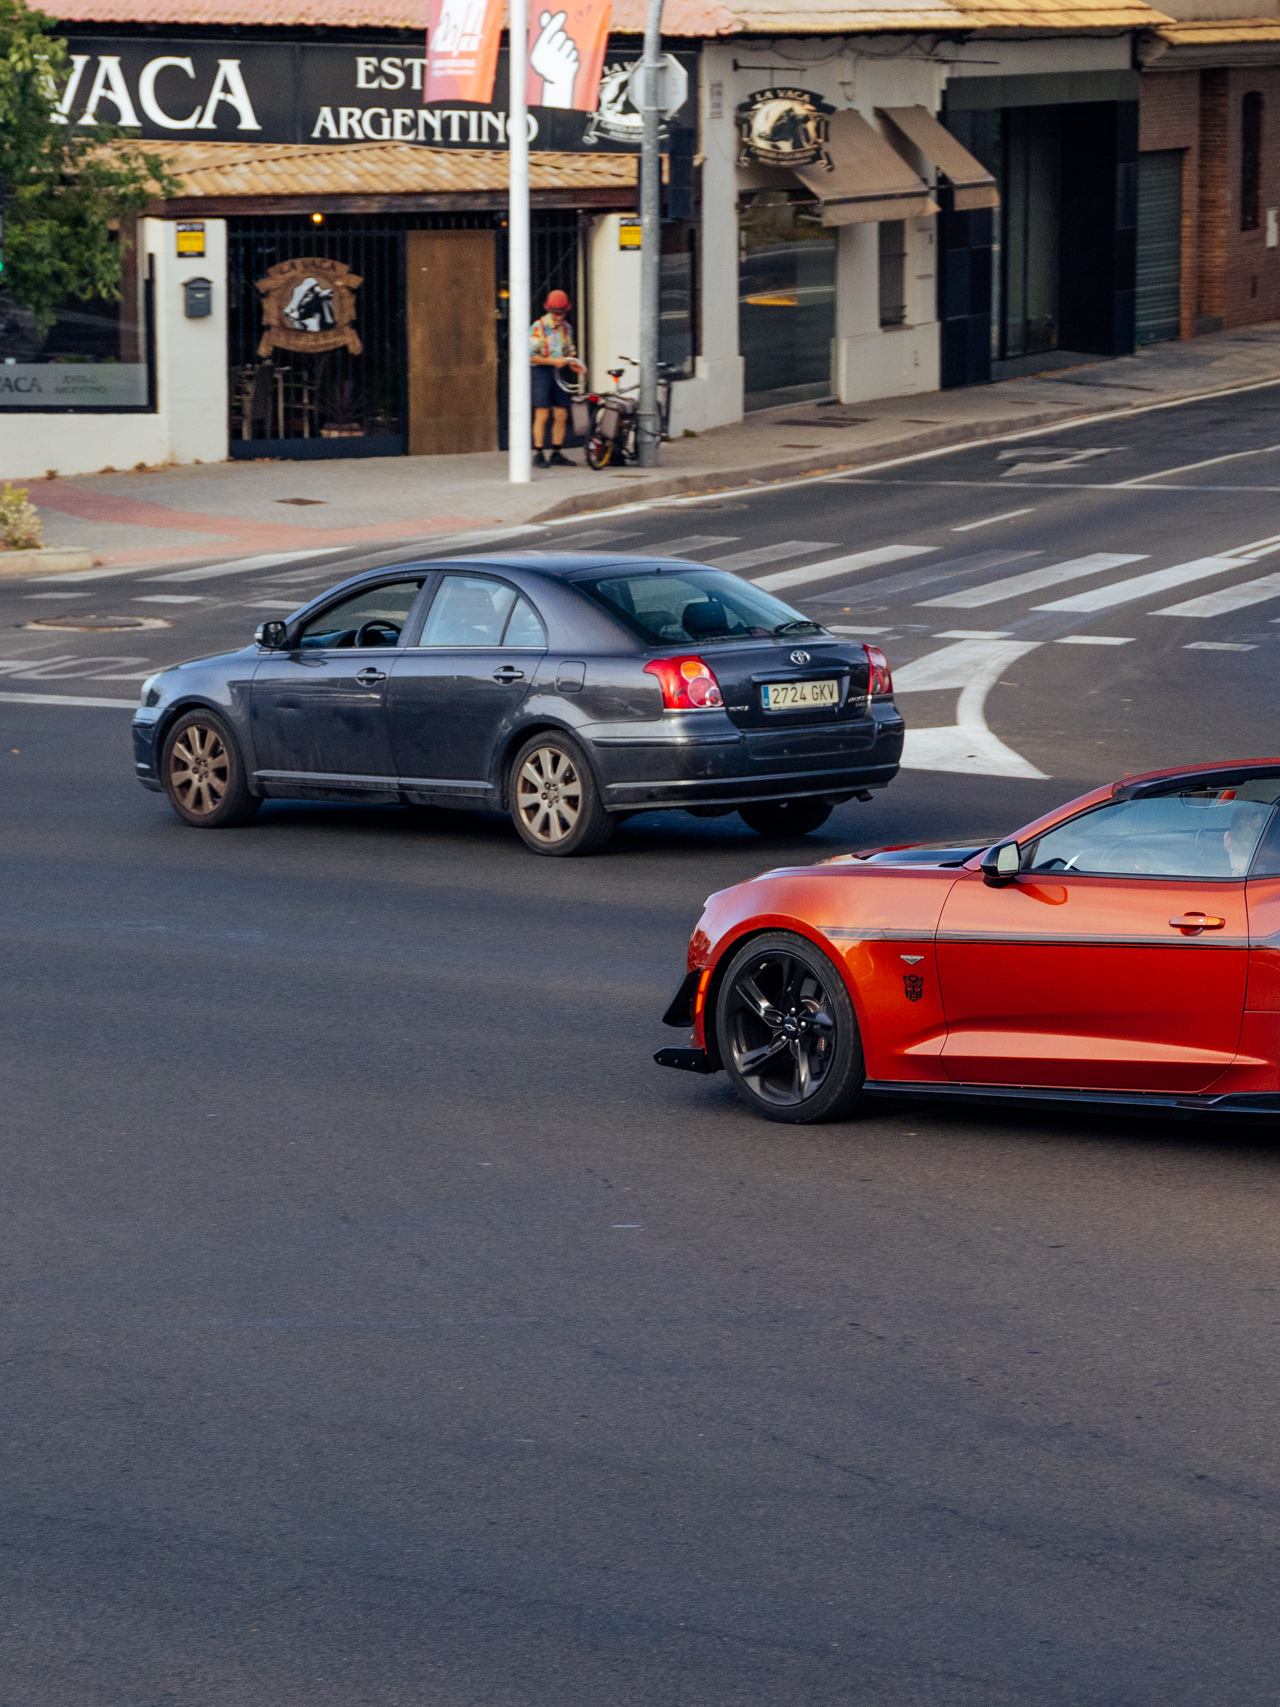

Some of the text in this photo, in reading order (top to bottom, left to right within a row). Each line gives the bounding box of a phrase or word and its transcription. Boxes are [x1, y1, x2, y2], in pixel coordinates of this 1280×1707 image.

[33, 54, 262, 130] VACA
[755, 89, 811, 103] LA VACA
[772, 683, 835, 705] 2724 GKV
